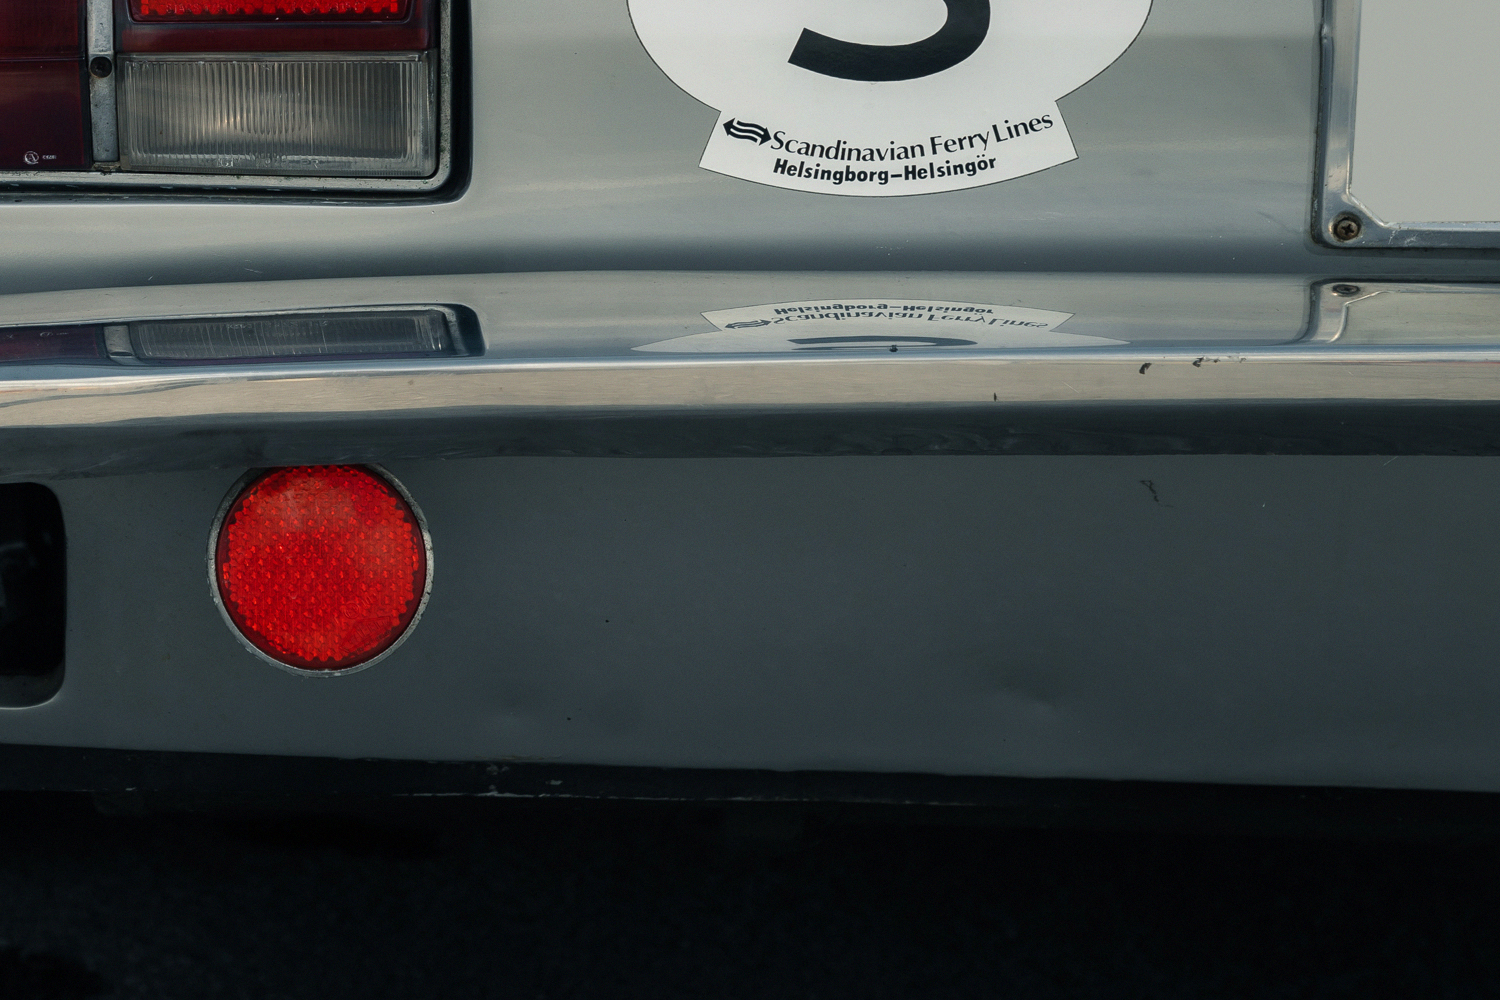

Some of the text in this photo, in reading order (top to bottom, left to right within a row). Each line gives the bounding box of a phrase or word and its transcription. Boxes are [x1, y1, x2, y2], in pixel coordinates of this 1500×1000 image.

[770, 114, 1054, 162] Scandinavian Ferry Lines
